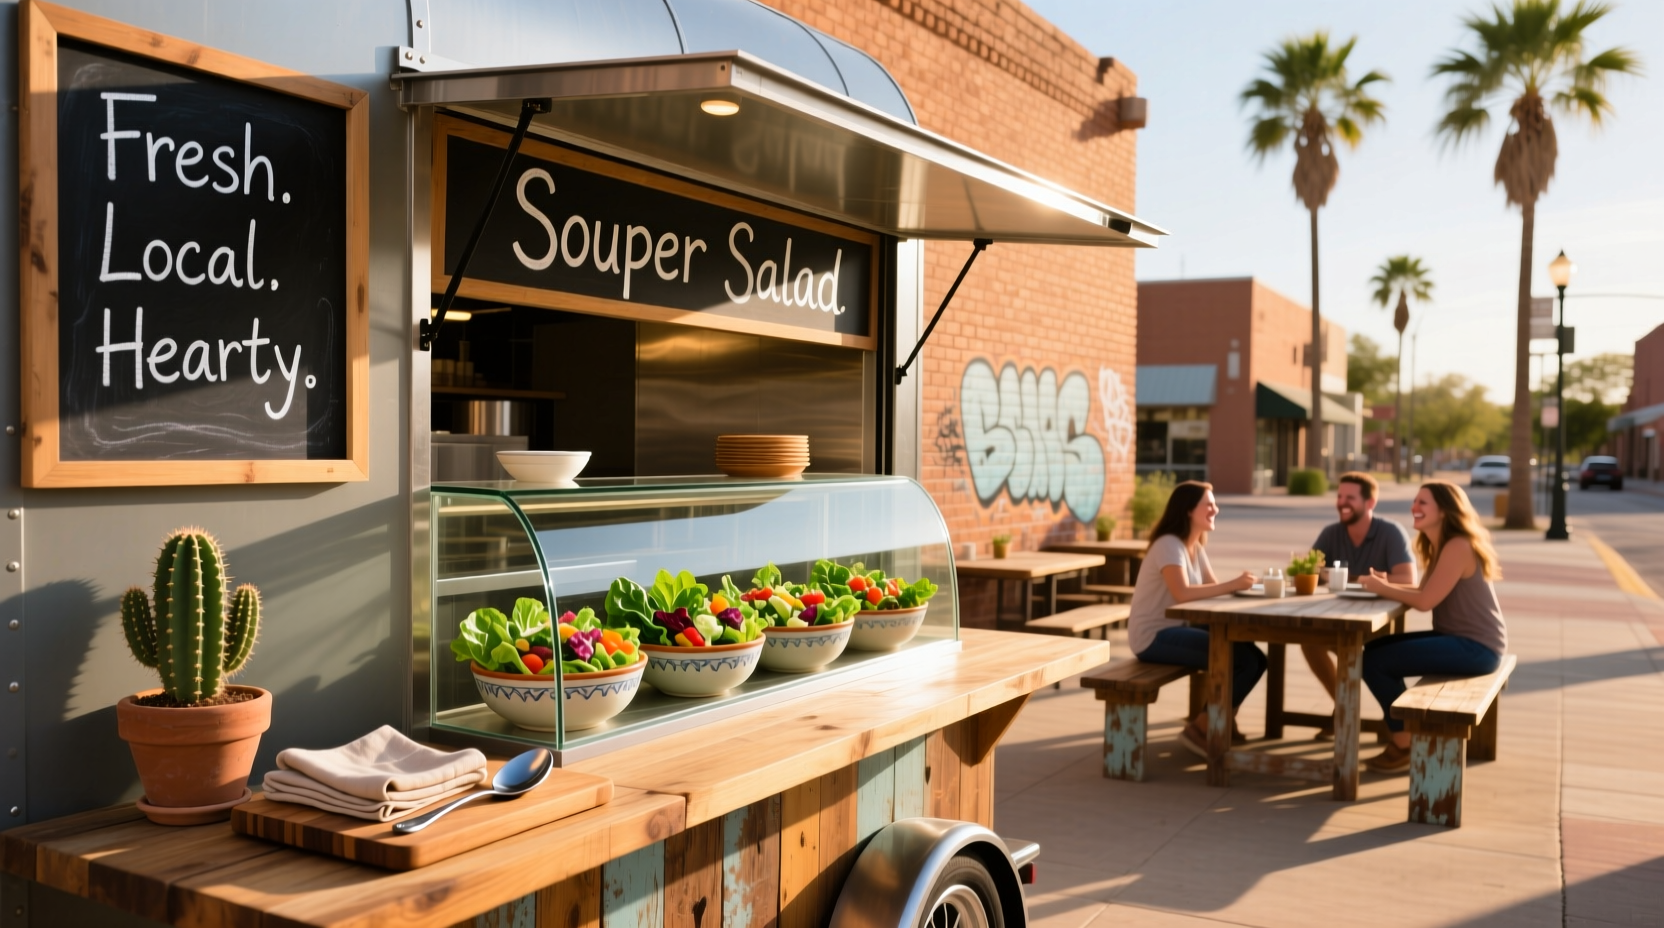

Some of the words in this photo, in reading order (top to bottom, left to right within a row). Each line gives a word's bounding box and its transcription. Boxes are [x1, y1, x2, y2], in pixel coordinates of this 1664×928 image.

[100, 91, 291, 204] Fresh.
[99, 201, 279, 291] Local.
[512, 167, 708, 300] Souper
[724, 221, 847, 316] Salad.
[95, 306, 317, 420] Hearty.
